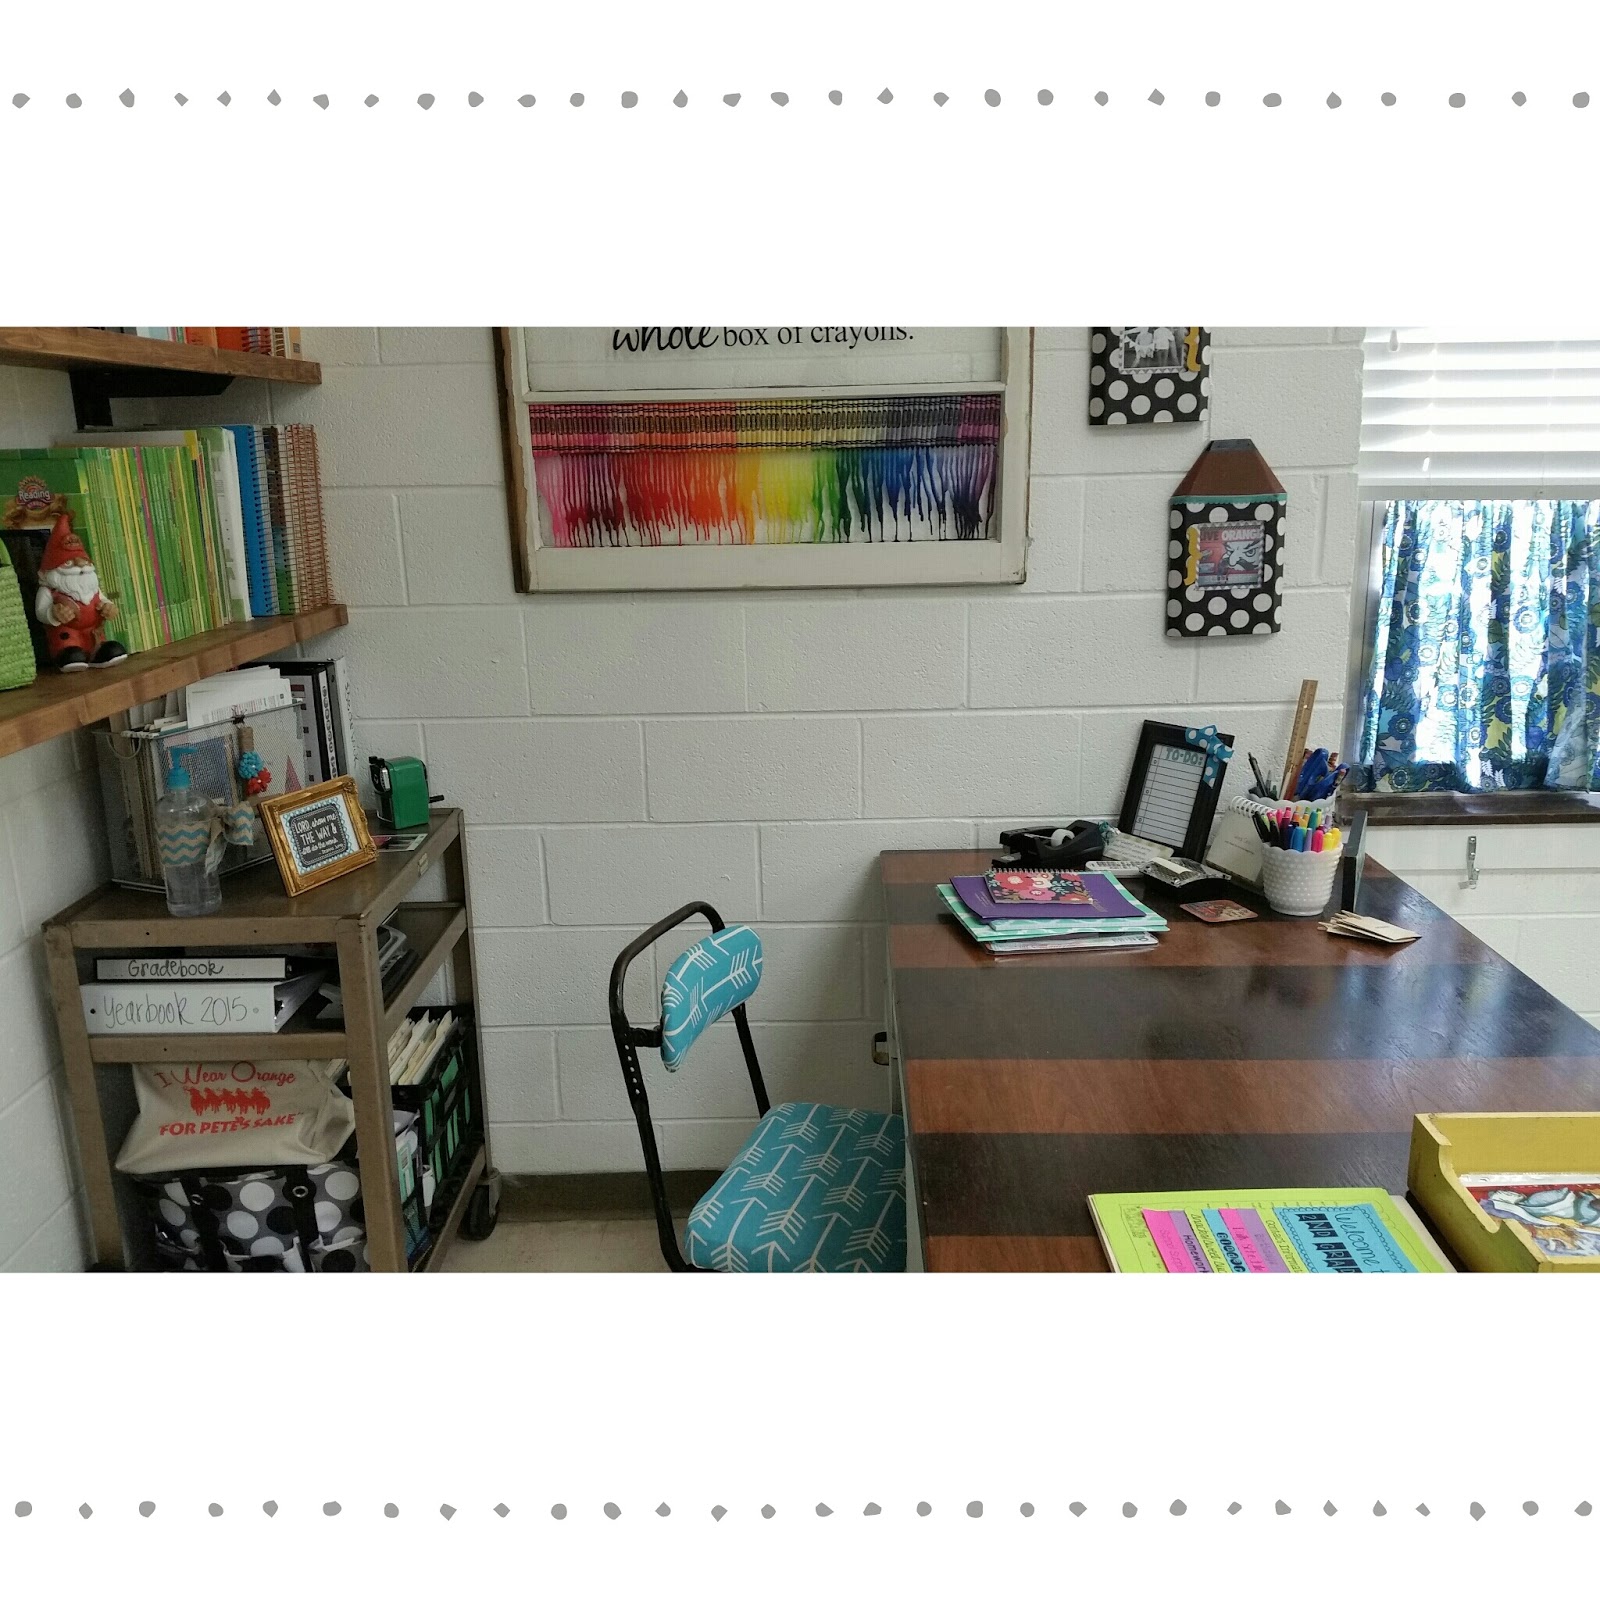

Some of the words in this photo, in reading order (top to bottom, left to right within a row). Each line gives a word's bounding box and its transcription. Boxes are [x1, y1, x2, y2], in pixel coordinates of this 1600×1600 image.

[723, 327, 769, 347] box
[18, 490, 51, 502] Reading
[300, 831, 315, 845] THE
[315, 825, 330, 840] WAY
[128, 959, 224, 977] Gradebook
[200, 996, 248, 1026] 2015
[153, 1072, 172, 1088] I
[171, 1063, 227, 1085] Wear
[231, 1060, 296, 1087] Orange
[159, 1122, 196, 1136] FOR
[252, 1113, 296, 1129] SAKE
[1265, 1220, 1285, 1246] Contact
[1301, 1214, 1332, 1237] 2ND
[1334, 1212, 1380, 1266] Welcome
